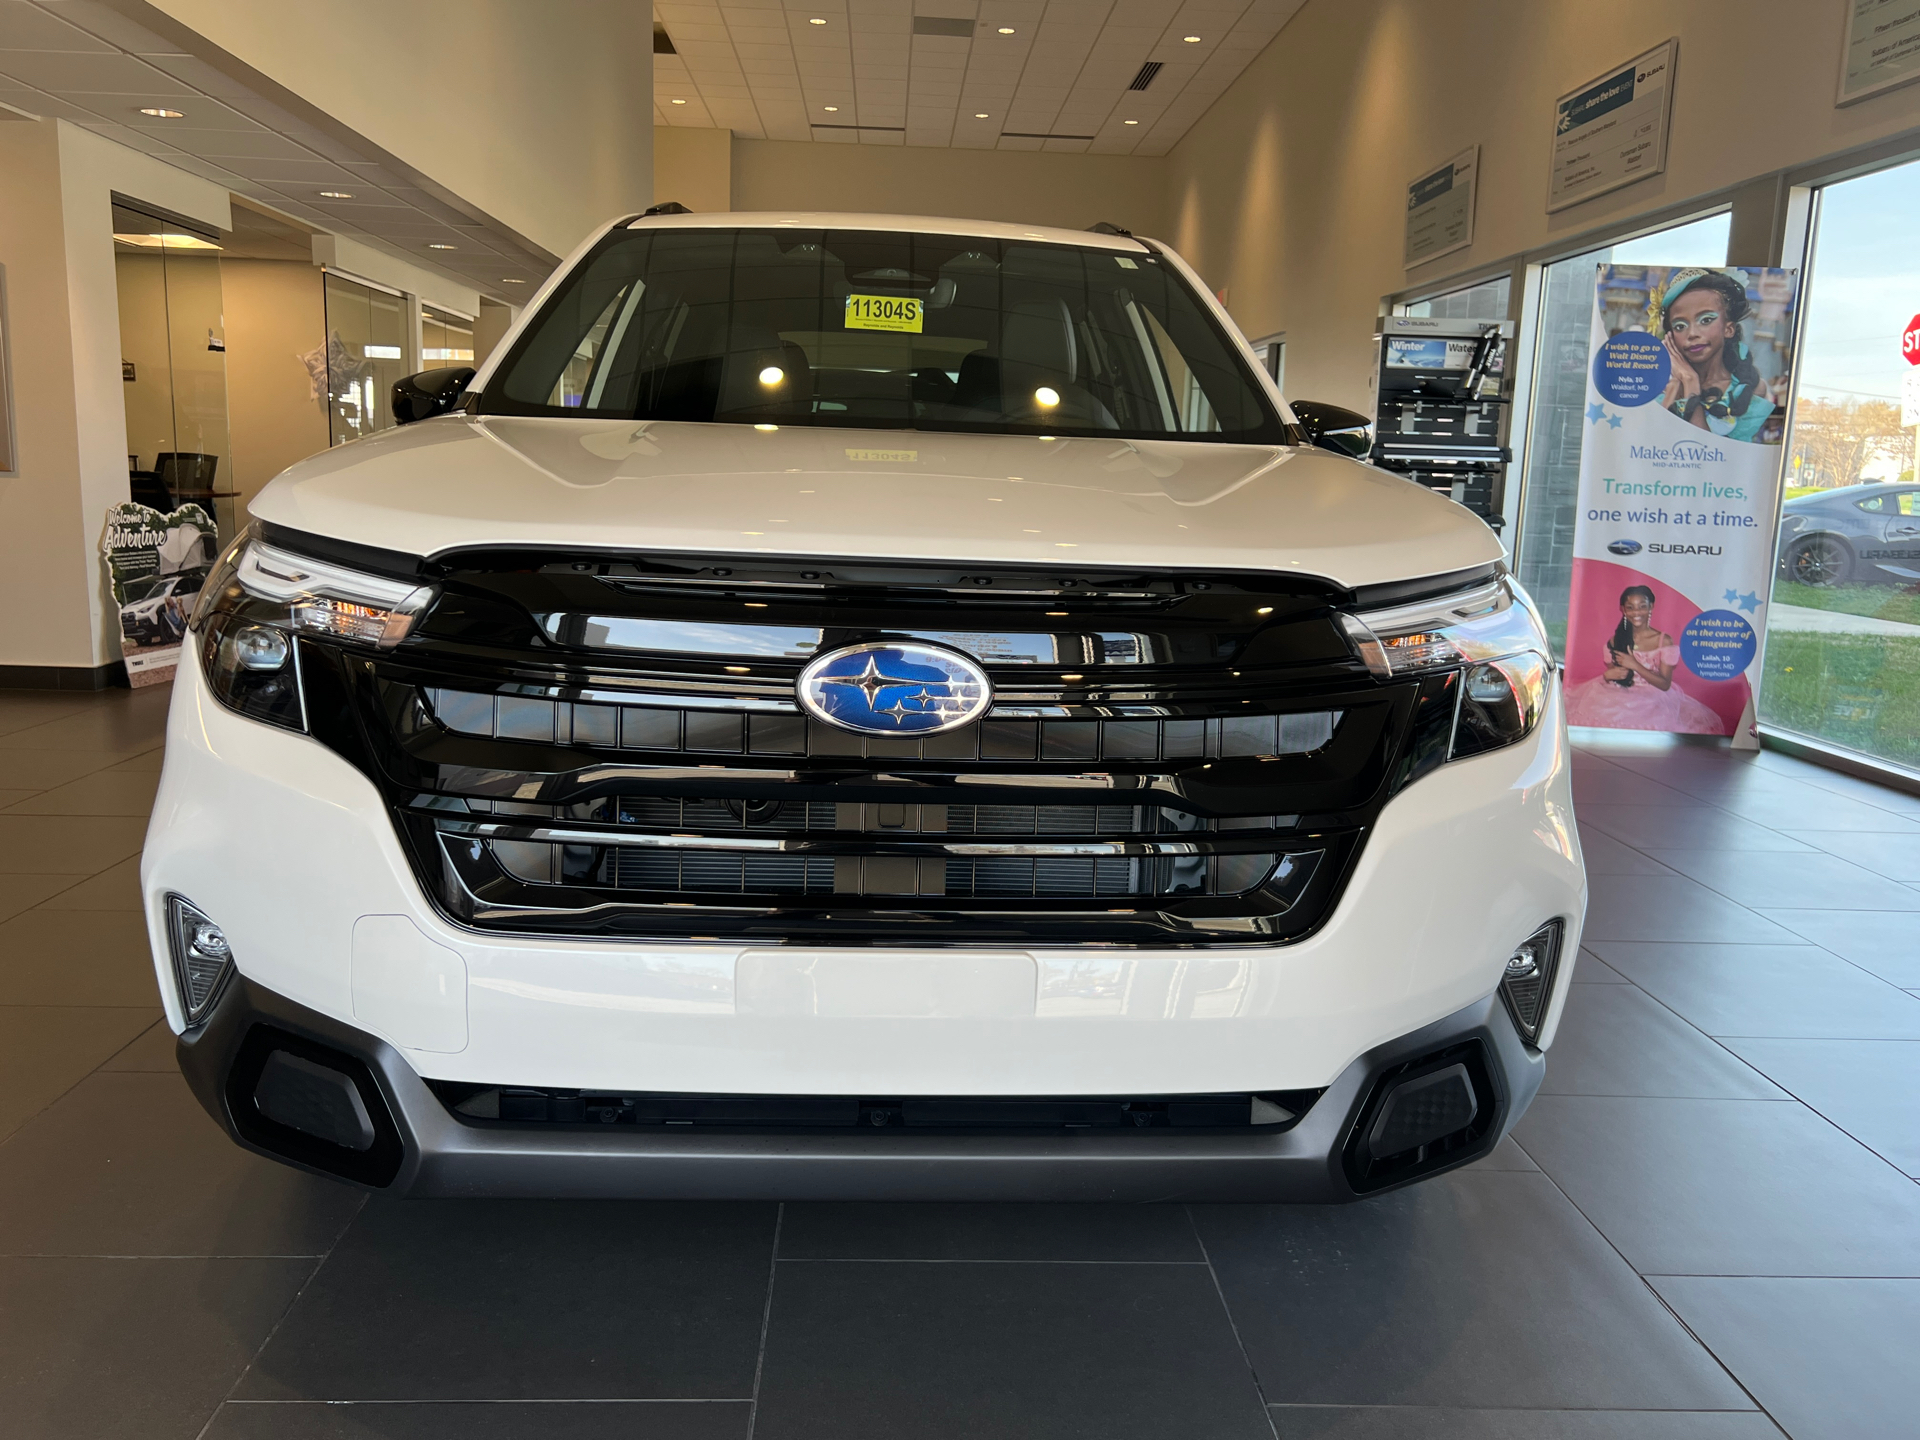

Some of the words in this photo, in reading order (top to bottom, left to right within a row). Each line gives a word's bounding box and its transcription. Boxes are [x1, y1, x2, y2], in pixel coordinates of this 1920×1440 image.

[1646, 63, 1666, 78] SUBARU
[853, 298, 916, 320] 11304S
[1391, 340, 1425, 351] Winter
[1903, 329, 1920, 354] ST
[1611, 343, 1629, 352] wish
[1631, 344, 1640, 352] to
[1640, 345, 1650, 353] go
[1652, 344, 1661, 352] to
[1609, 352, 1629, 360] Walt
[1630, 353, 1657, 362] Disney
[1606, 361, 1631, 369] World
[1632, 362, 1659, 370] Resort
[1602, 478, 1697, 498] Transform
[1702, 481, 1748, 502] lives,
[109, 508, 142, 525] Welcome
[143, 510, 151, 523] to
[1587, 510, 1621, 523] one
[1627, 507, 1668, 525] wish
[1673, 510, 1692, 526] at
[1696, 514, 1707, 526] a
[1712, 510, 1758, 528] time.
[103, 524, 167, 549] Adventure
[1648, 543, 1722, 556] SUBARU
[1701, 618, 1721, 628] wish
[1723, 620, 1732, 628] to
[1733, 619, 1744, 628] be
[1699, 629, 1713, 637] the
[1715, 630, 1739, 638] cover
[1741, 630, 1752, 640] of
[1700, 640, 1743, 649] magazine
[1699, 670, 1730, 678] lymphoma
